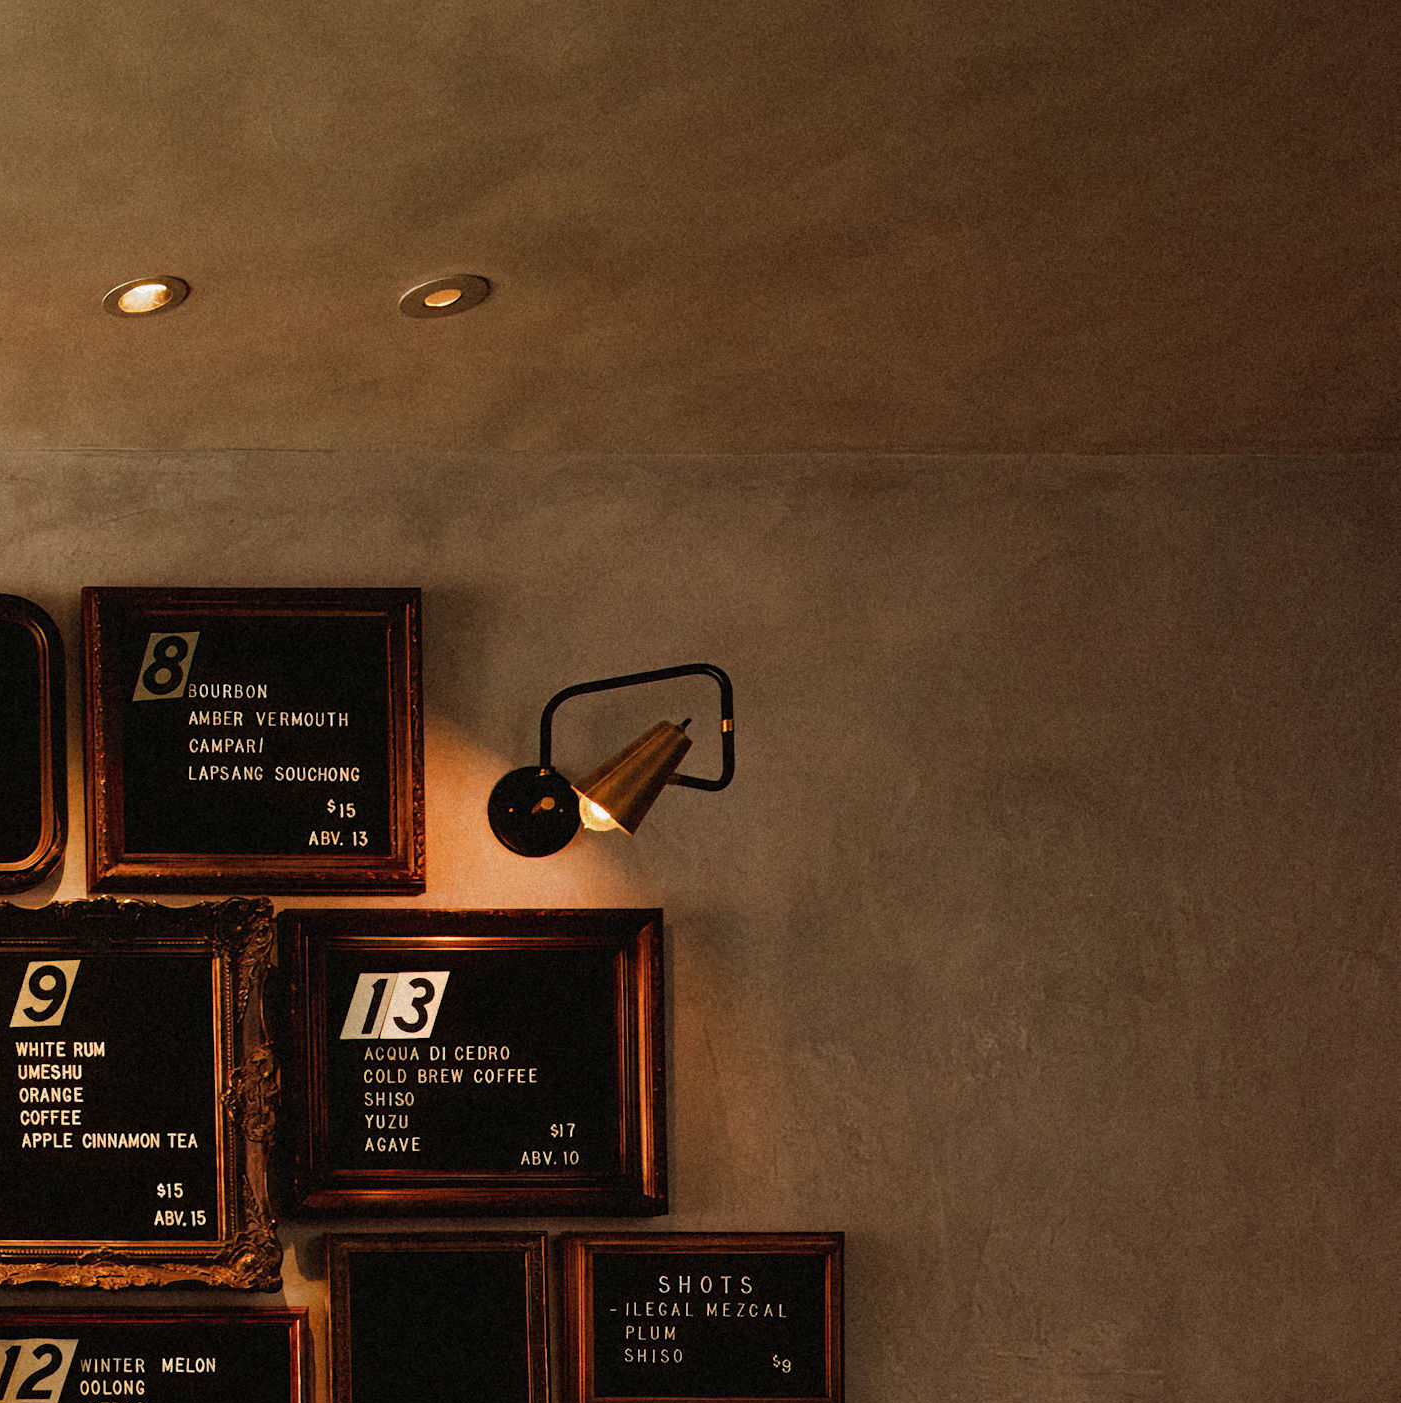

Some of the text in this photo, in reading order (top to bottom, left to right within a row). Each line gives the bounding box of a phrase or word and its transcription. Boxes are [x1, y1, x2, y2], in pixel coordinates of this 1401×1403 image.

[142, 635, 189, 696] 8
[189, 684, 267, 698] BOURBON
[189, 711, 348, 726] AMBER VERMOUTH
[189, 766, 359, 781] LAPSANG SOUCHONG
[23, 965, 68, 1022] 9
[361, 976, 436, 1035] 13
[16, 1041, 105, 1057] WHITE RUM
[365, 1046, 509, 1061] ACQUA DI CEDRO
[18, 1064, 82, 1080] UMESHU
[364, 1068, 537, 1083] COLD BREW COFFEE
[19, 1087, 83, 1103] ORANGE
[365, 1092, 414, 1106] SHISO
[20, 1110, 81, 1126] COFFEE
[365, 1115, 408, 1129] YUZU
[22, 1133, 198, 1148] APPLE CINNAMON TEA
[365, 1123, 575, 1152] AGAVE $17
[157, 1183, 183, 1198] $15
[659, 1276, 752, 1294] SHOTS
[707, 1303, 786, 1317] MEZCAL
[626, 1326, 675, 1340] PLUM
[625, 1348, 682, 1363] SHISO
[81, 1357, 215, 1373] WINTER MELON
[80, 1380, 144, 1395] OOLONG
